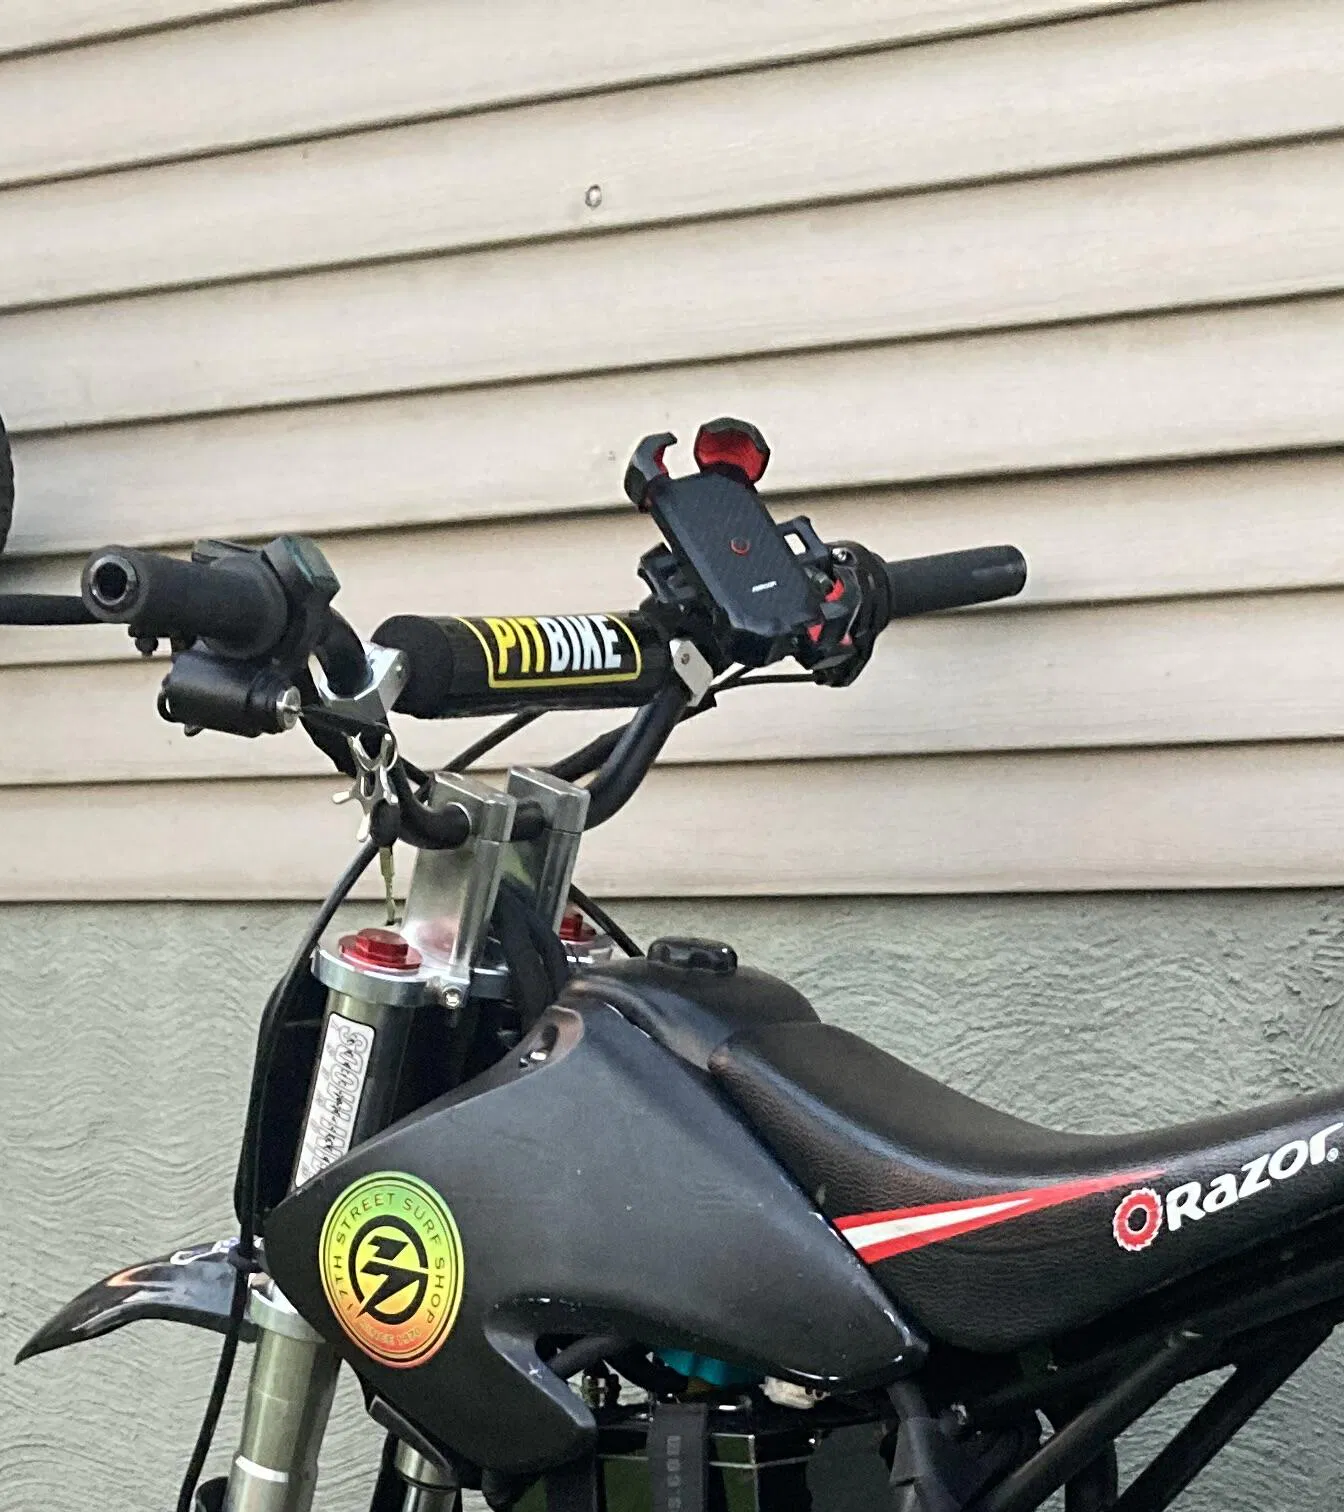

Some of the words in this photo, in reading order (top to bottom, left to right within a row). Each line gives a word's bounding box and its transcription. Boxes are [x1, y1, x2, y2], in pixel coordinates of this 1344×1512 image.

[485, 616, 622, 674] PITBIKE
[325, 1026, 368, 1122] MODS
[1165, 1122, 1344, 1232] Razor
[336, 1192, 396, 1245] STREET
[401, 1198, 443, 1248] SURF
[333, 1255, 354, 1312] 17TH
[426, 1256, 446, 1325] SHOP
